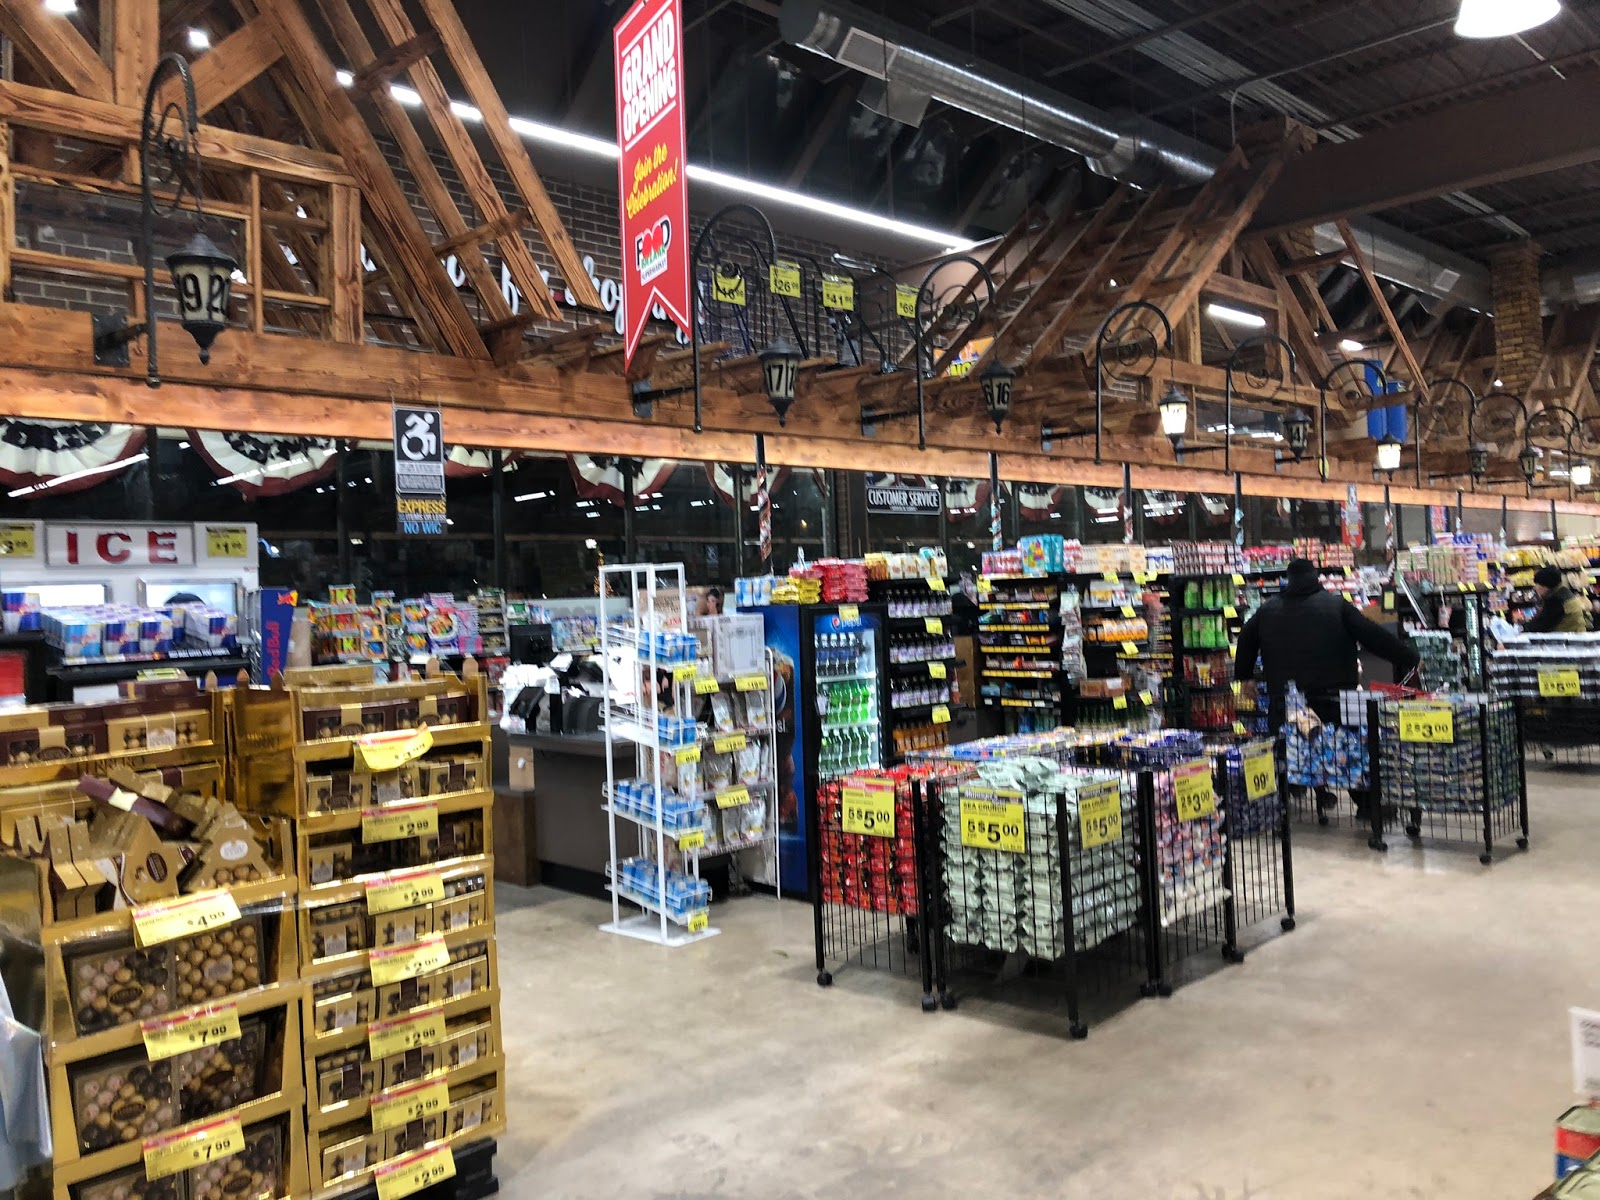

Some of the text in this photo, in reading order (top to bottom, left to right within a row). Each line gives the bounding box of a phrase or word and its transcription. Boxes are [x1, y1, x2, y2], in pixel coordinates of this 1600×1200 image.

[621, 8, 675, 104] GRAND
[623, 55, 677, 142] OPENING
[626, 156, 678, 220] Celebration!
[632, 142, 668, 194] Join the
[397, 500, 447, 514] EXPRESS
[868, 488, 939, 508] CUSTOMER SERVICE
[65, 529, 179, 565] ICE
[404, 522, 419, 535] NO
